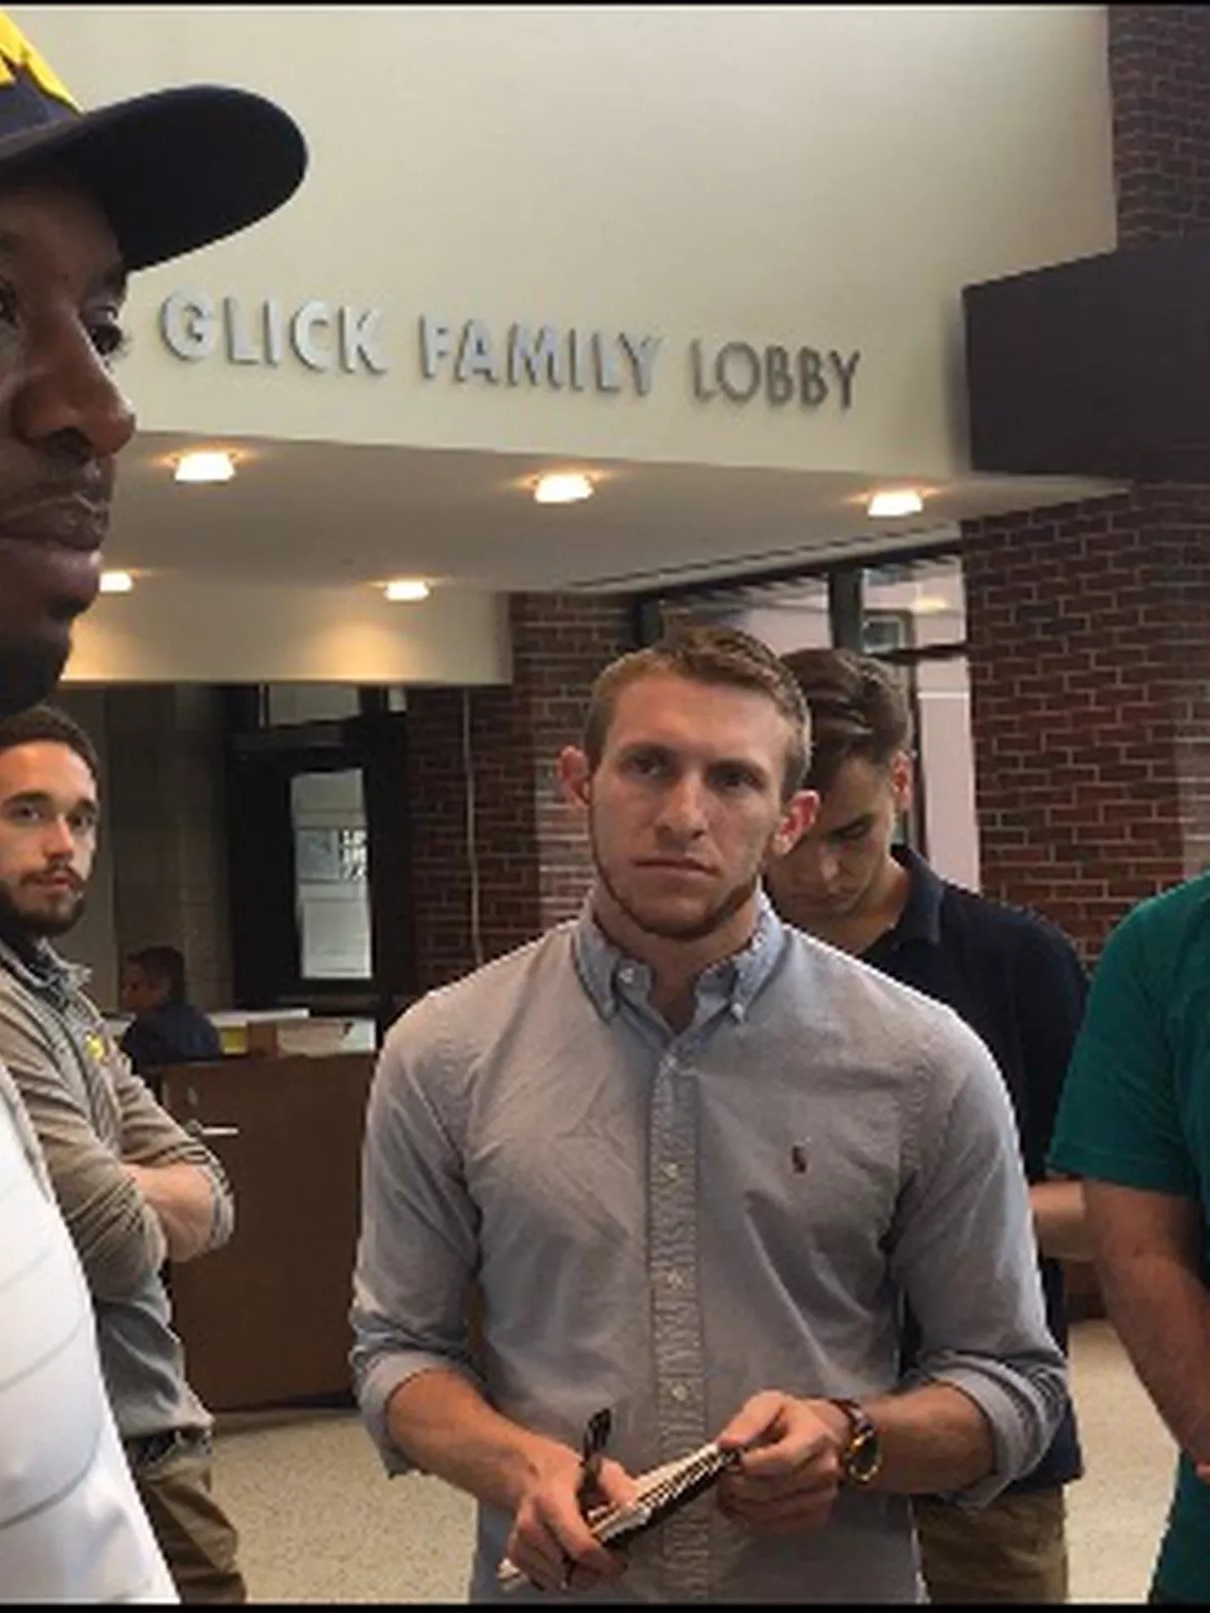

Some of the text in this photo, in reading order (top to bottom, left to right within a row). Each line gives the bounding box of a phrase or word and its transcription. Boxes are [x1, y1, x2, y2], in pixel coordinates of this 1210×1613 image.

[159, 284, 862, 410] GLICK FAMILY LOBBY
